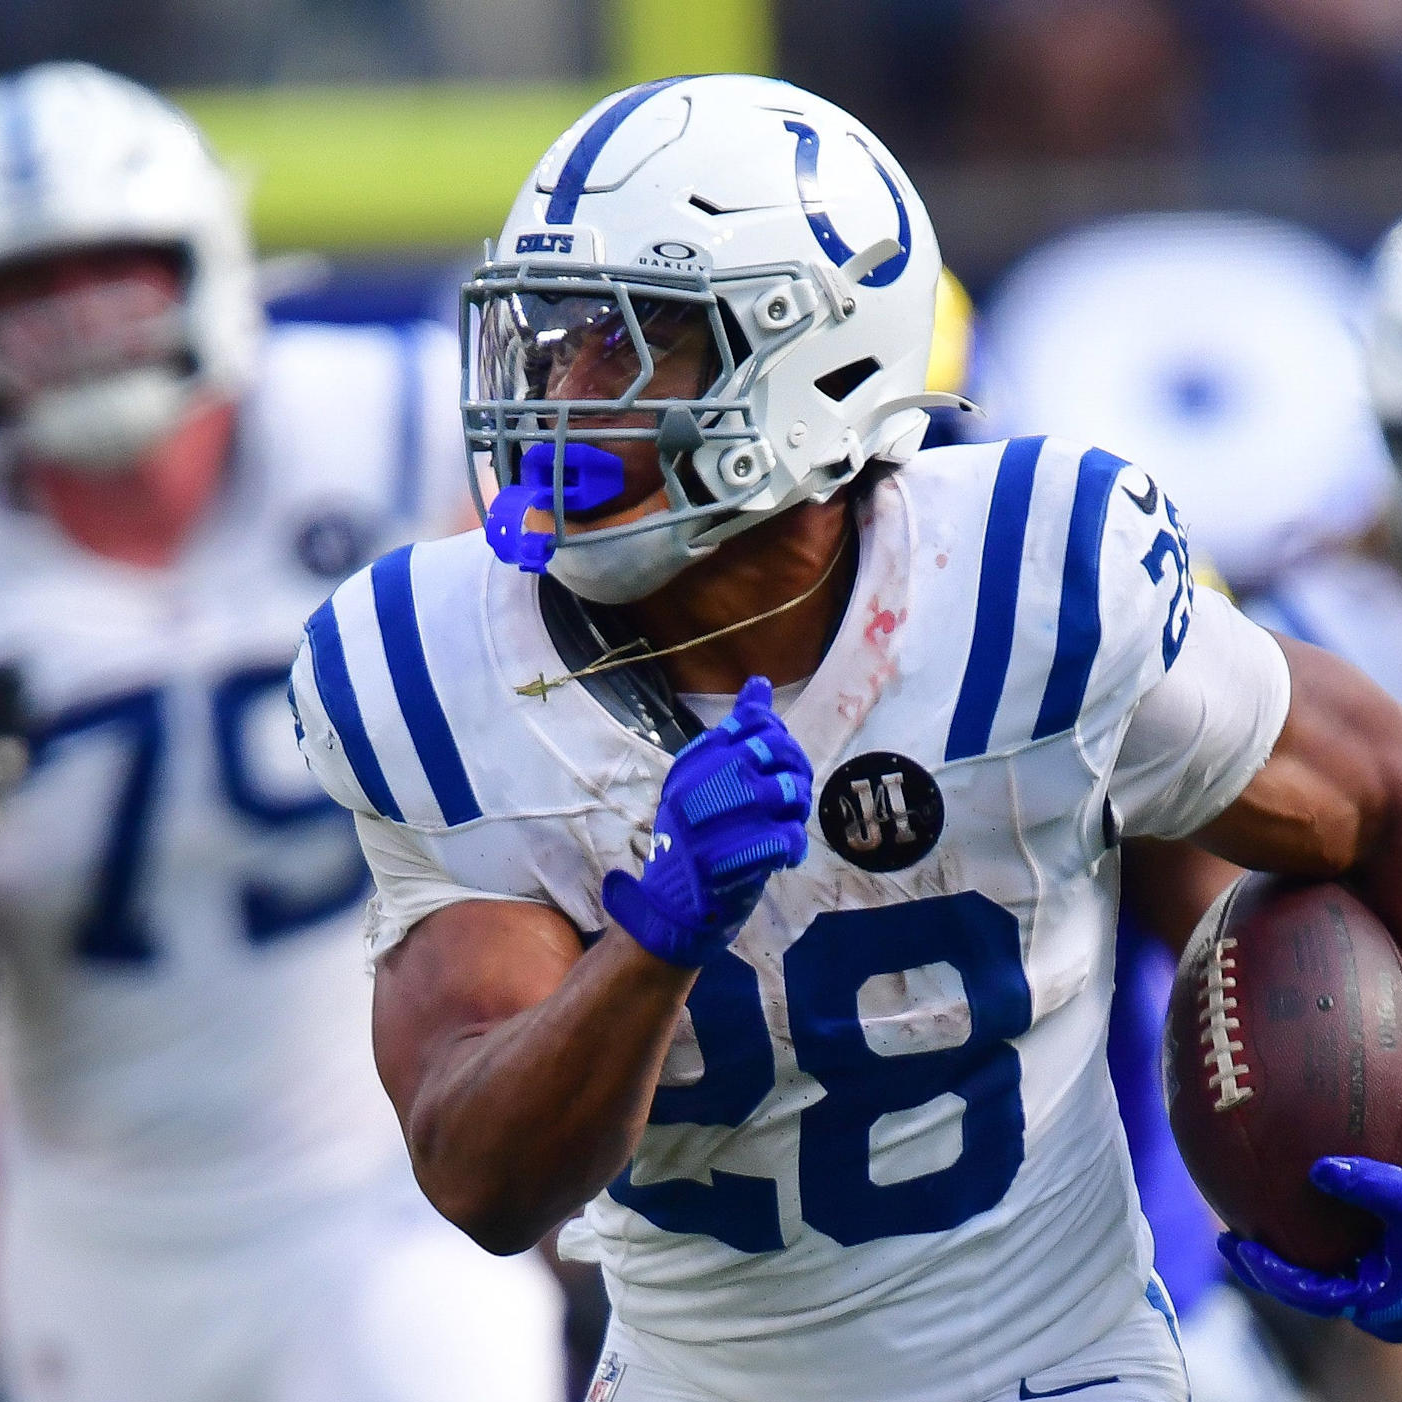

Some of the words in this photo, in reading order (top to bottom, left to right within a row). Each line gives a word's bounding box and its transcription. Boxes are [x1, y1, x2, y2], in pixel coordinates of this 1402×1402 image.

[515, 232, 575, 254] COLTS
[638, 256, 707, 273] OAKLEY
[603, 889, 1034, 1255] 28
